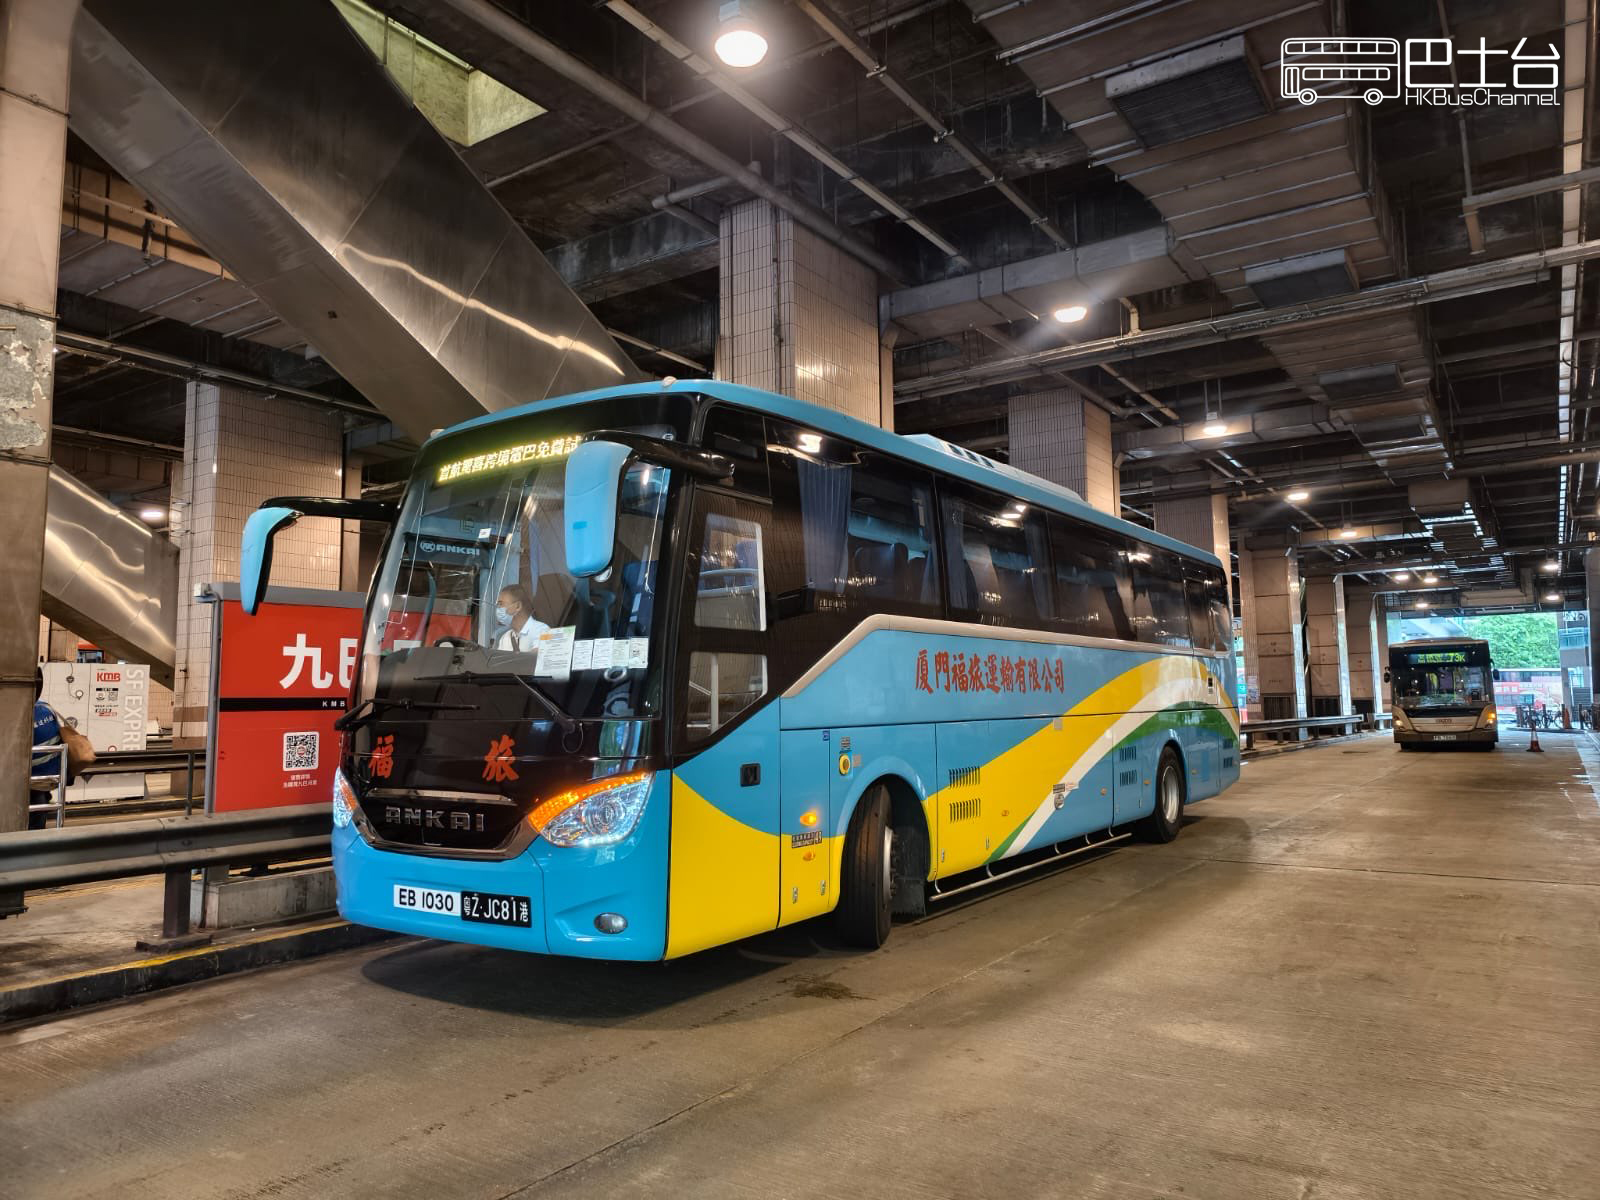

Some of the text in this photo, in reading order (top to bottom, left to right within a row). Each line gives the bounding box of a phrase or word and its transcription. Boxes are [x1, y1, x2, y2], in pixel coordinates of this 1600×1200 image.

[436, 544, 480, 556] ANKAI
[96, 672, 120, 683] KMB
[126, 668, 144, 690] SF
[368, 734, 519, 782] 福 旅
[385, 805, 485, 832] ANKAI
[399, 888, 454, 912] EB 1030
